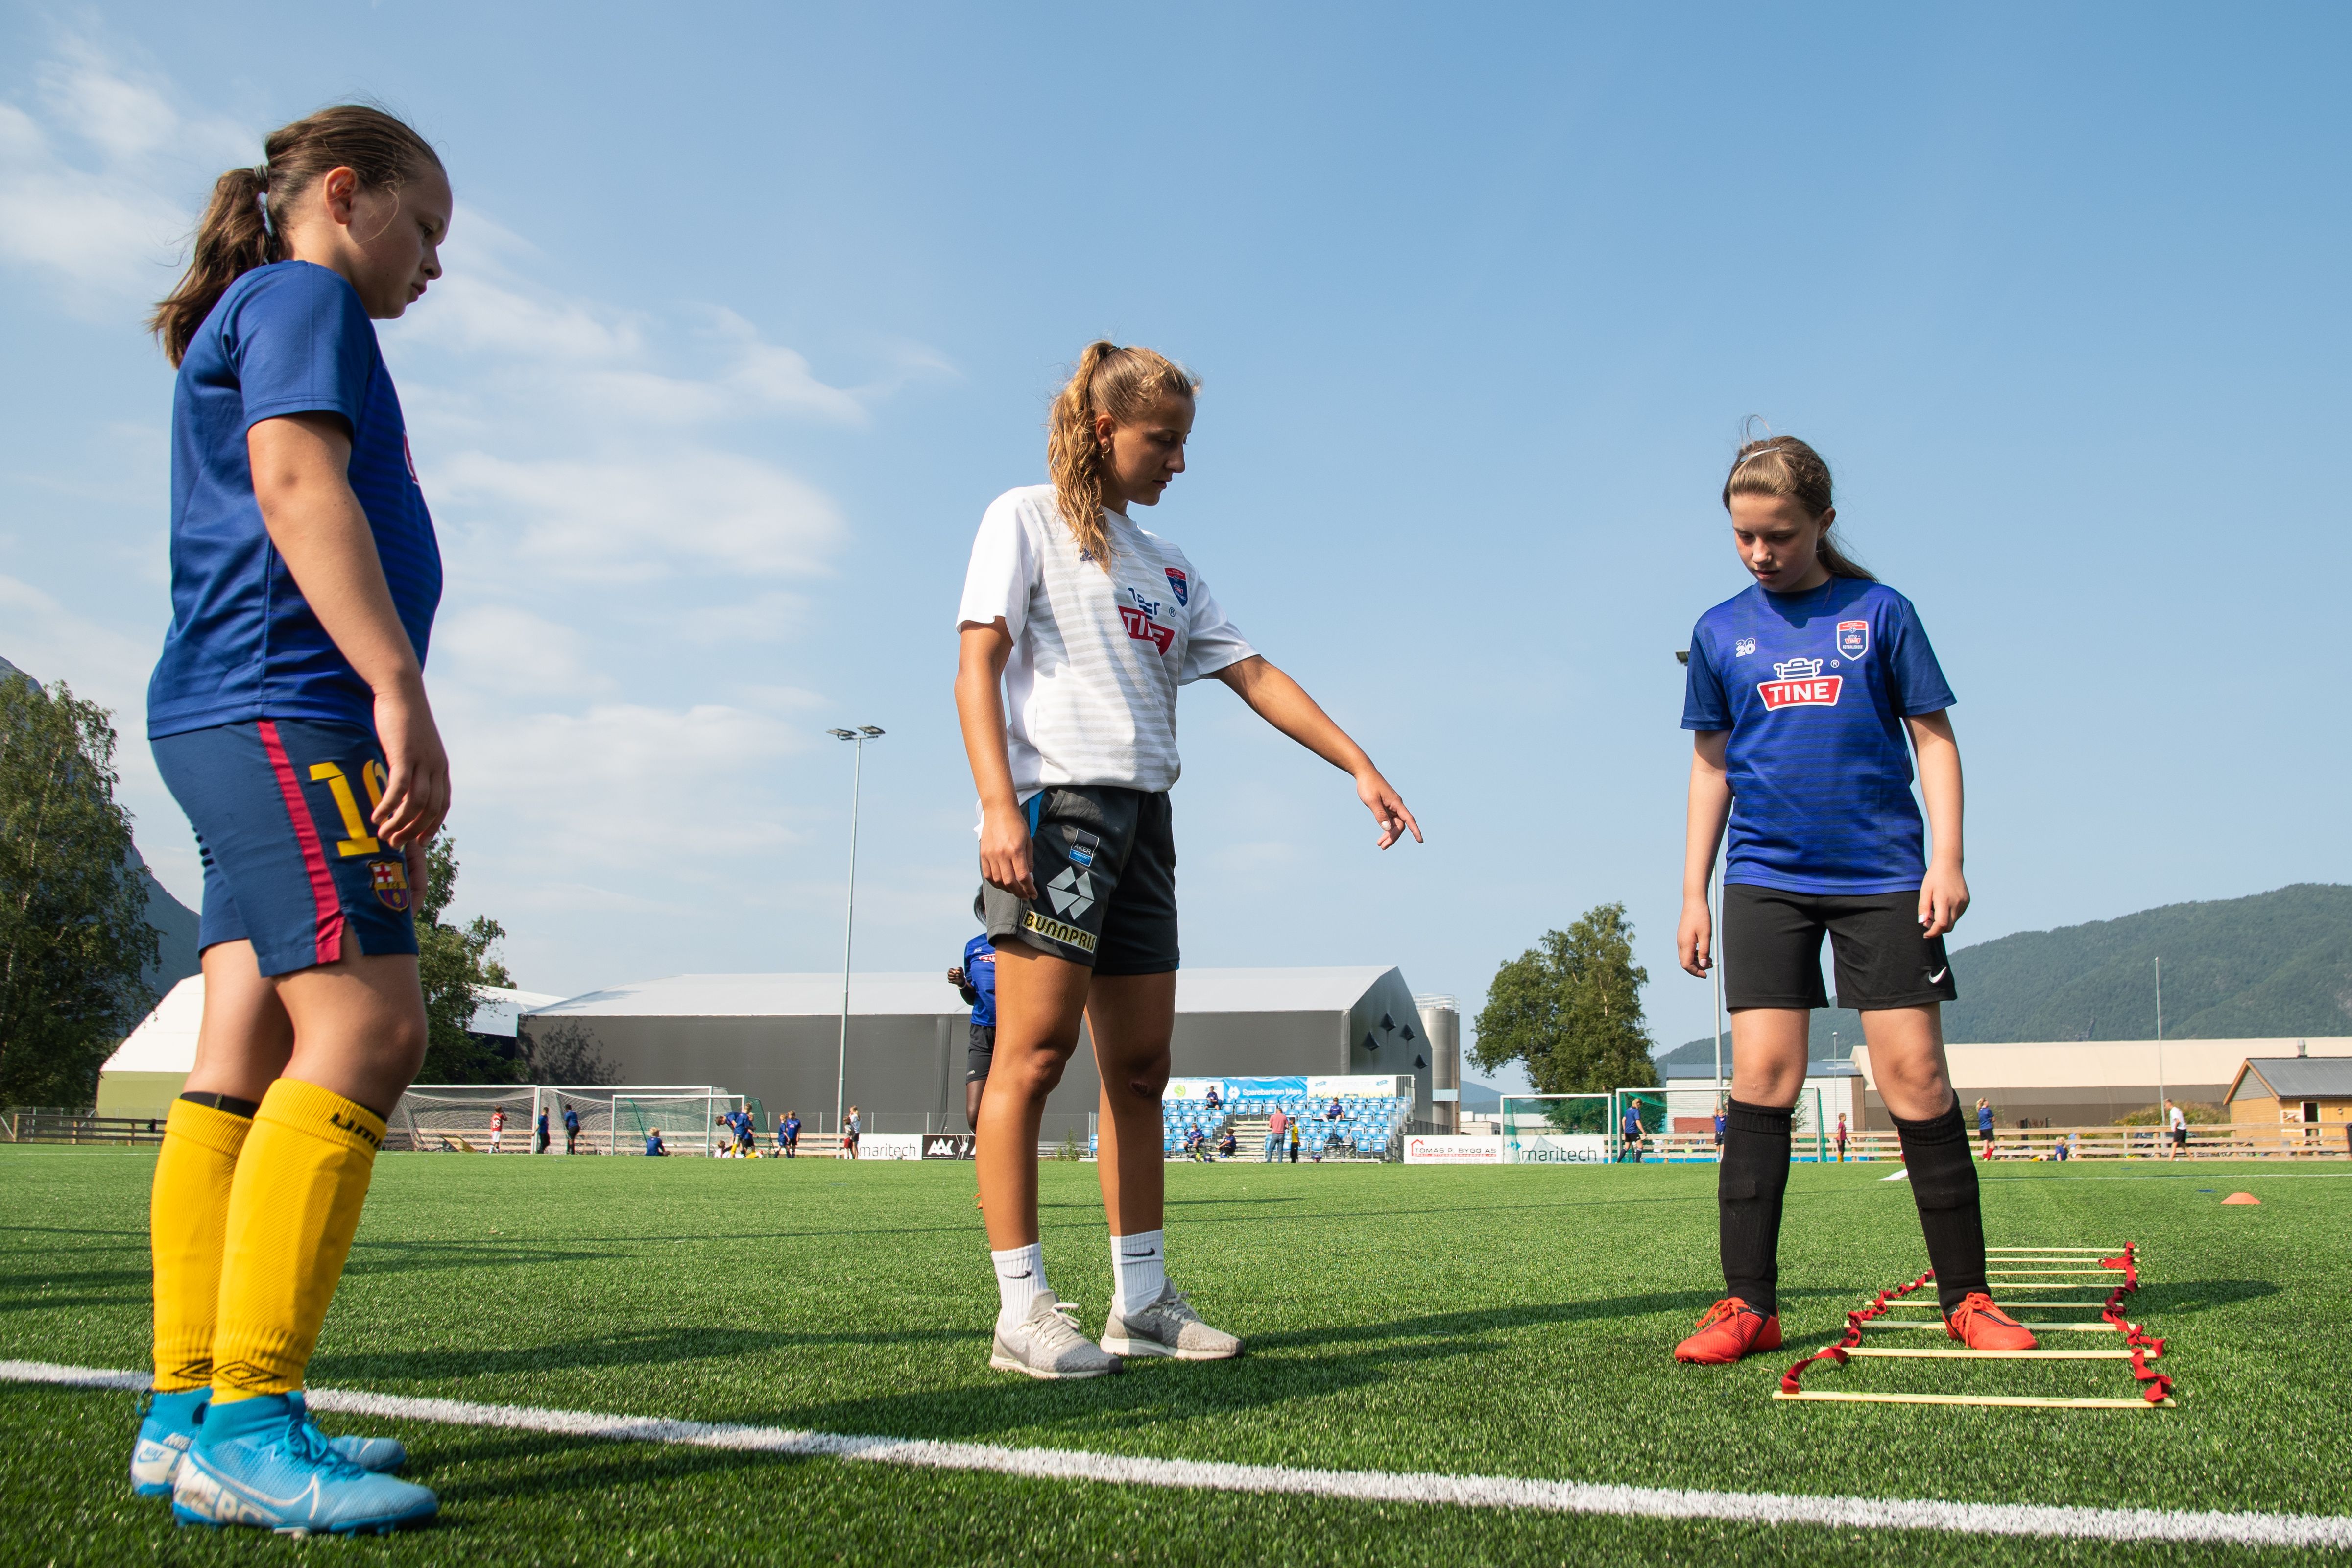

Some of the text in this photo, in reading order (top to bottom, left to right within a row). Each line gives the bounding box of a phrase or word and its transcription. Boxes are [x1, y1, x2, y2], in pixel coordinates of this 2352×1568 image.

[1768, 682, 1829, 703] TINE
[1074, 844, 1091, 854] AKER
[1242, 1088, 1285, 1097] Sparebanken
[859, 1143, 916, 1157] maritech
[1522, 1146, 1597, 1161] maritech
